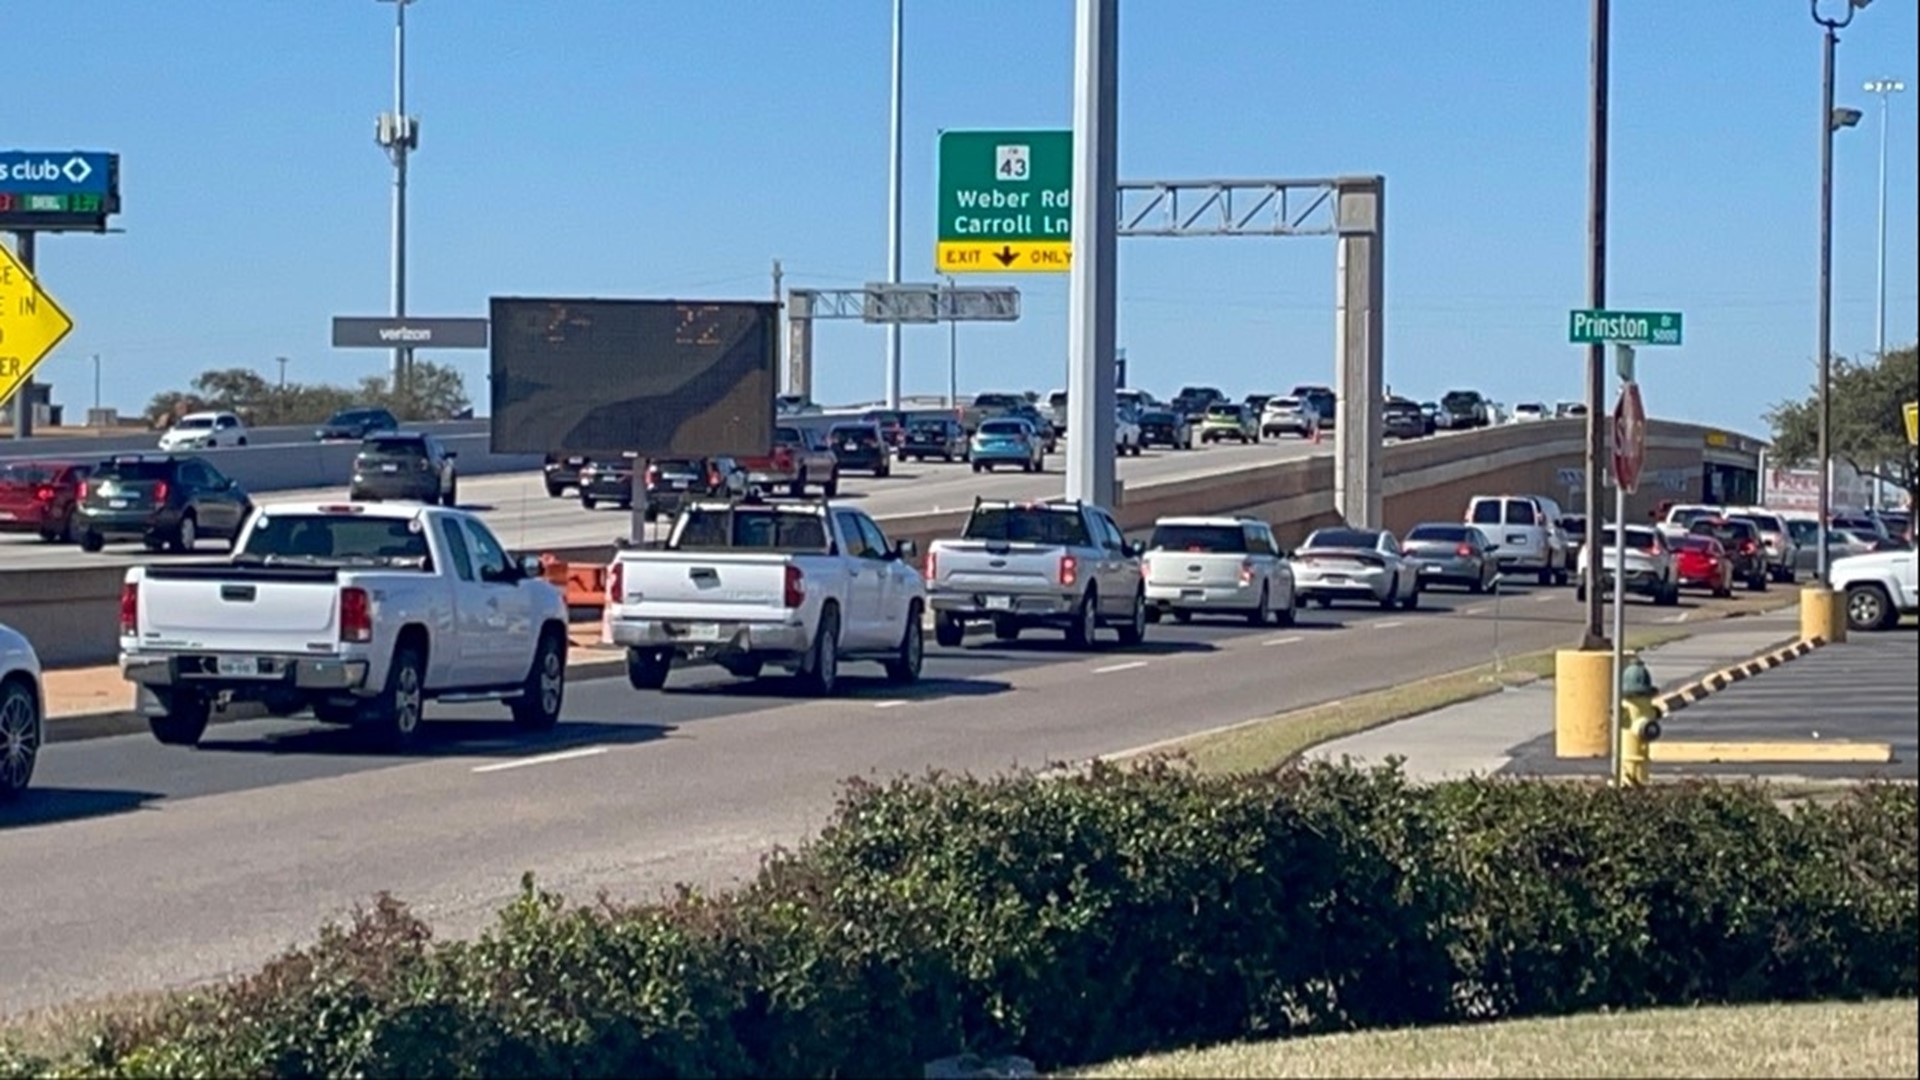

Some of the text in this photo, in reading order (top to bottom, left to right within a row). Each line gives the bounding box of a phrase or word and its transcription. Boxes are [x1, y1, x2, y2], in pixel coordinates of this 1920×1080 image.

[12, 159, 60, 180] club
[1000, 158, 1026, 177] 43
[956, 189, 1070, 208] Weber Rd
[954, 215, 1070, 233] Carroll Ln
[946, 249, 1072, 264] EXIT ONLY
[0, 265, 13, 285] E
[19, 295, 36, 316] IN
[379, 326, 431, 341] verizon
[1574, 313, 1648, 338] Prinston
